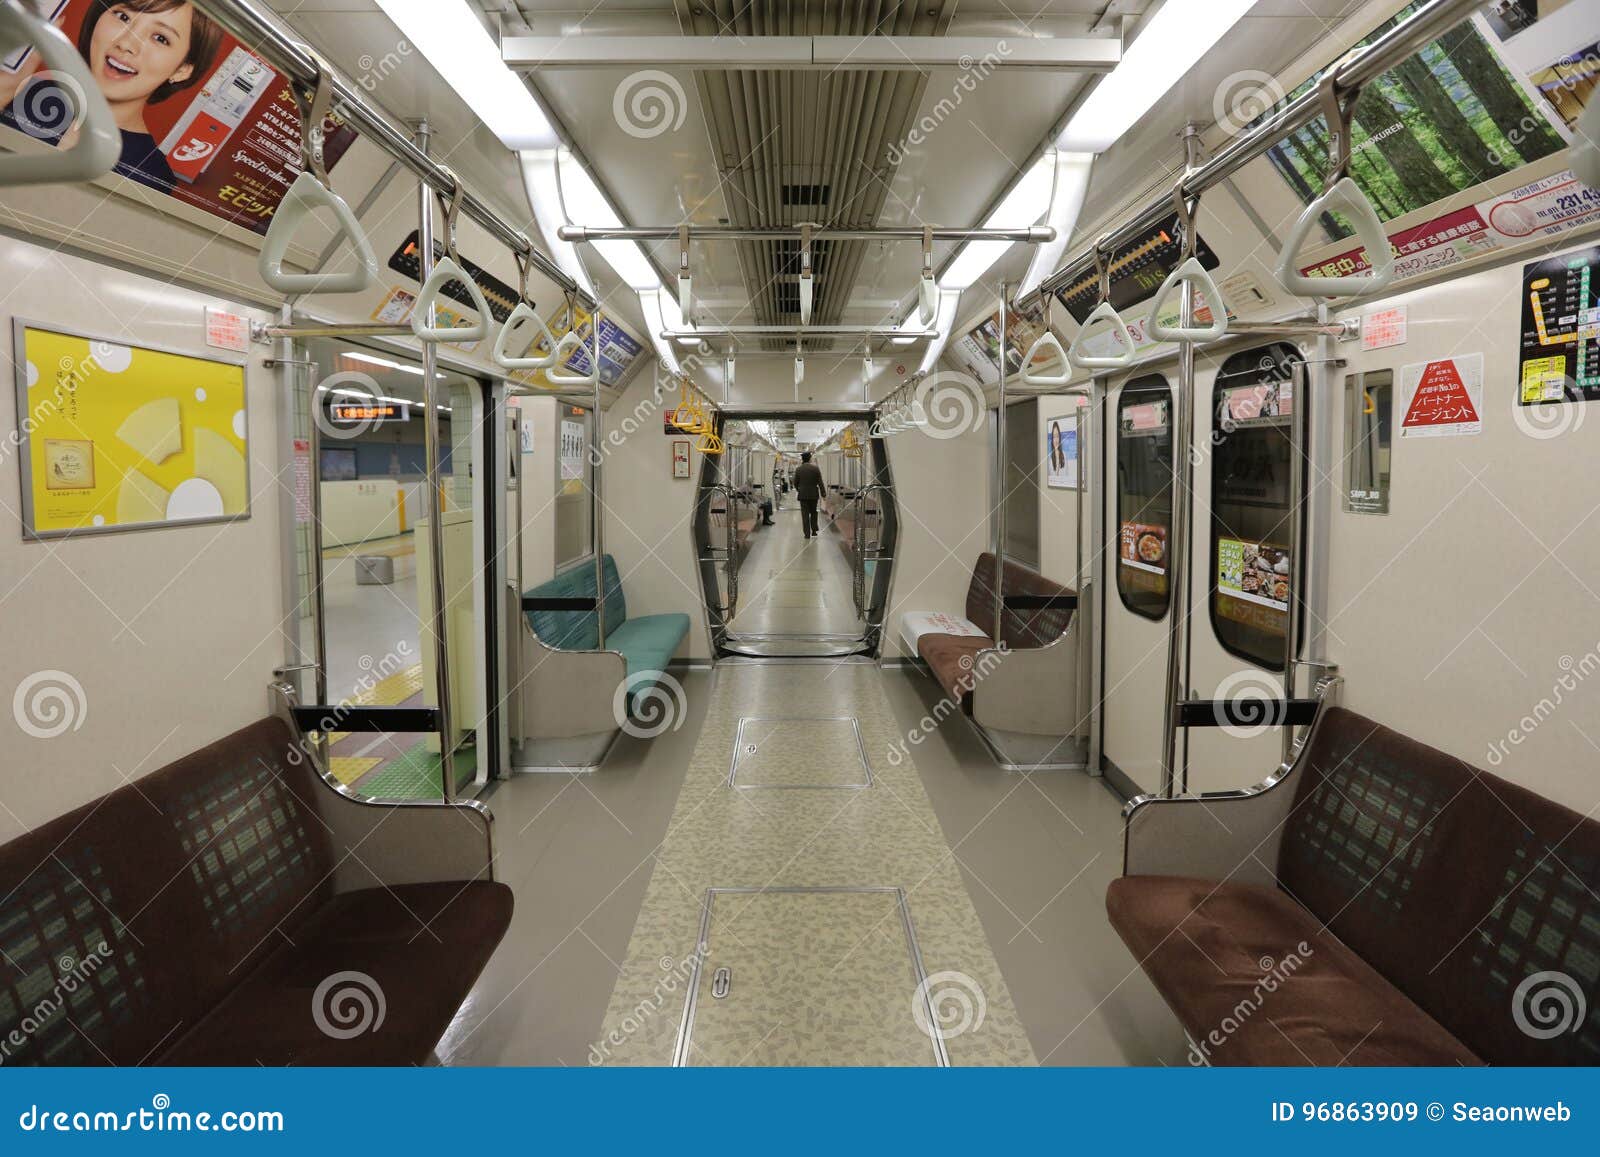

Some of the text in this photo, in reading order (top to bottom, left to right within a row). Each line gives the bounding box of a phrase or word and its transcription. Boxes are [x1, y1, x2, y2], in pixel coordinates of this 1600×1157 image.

[231, 149, 265, 173] Speed
[217, 184, 275, 218] モビット
[1416, 394, 1465, 407] パートナー
[1407, 405, 1473, 422] エージェント
